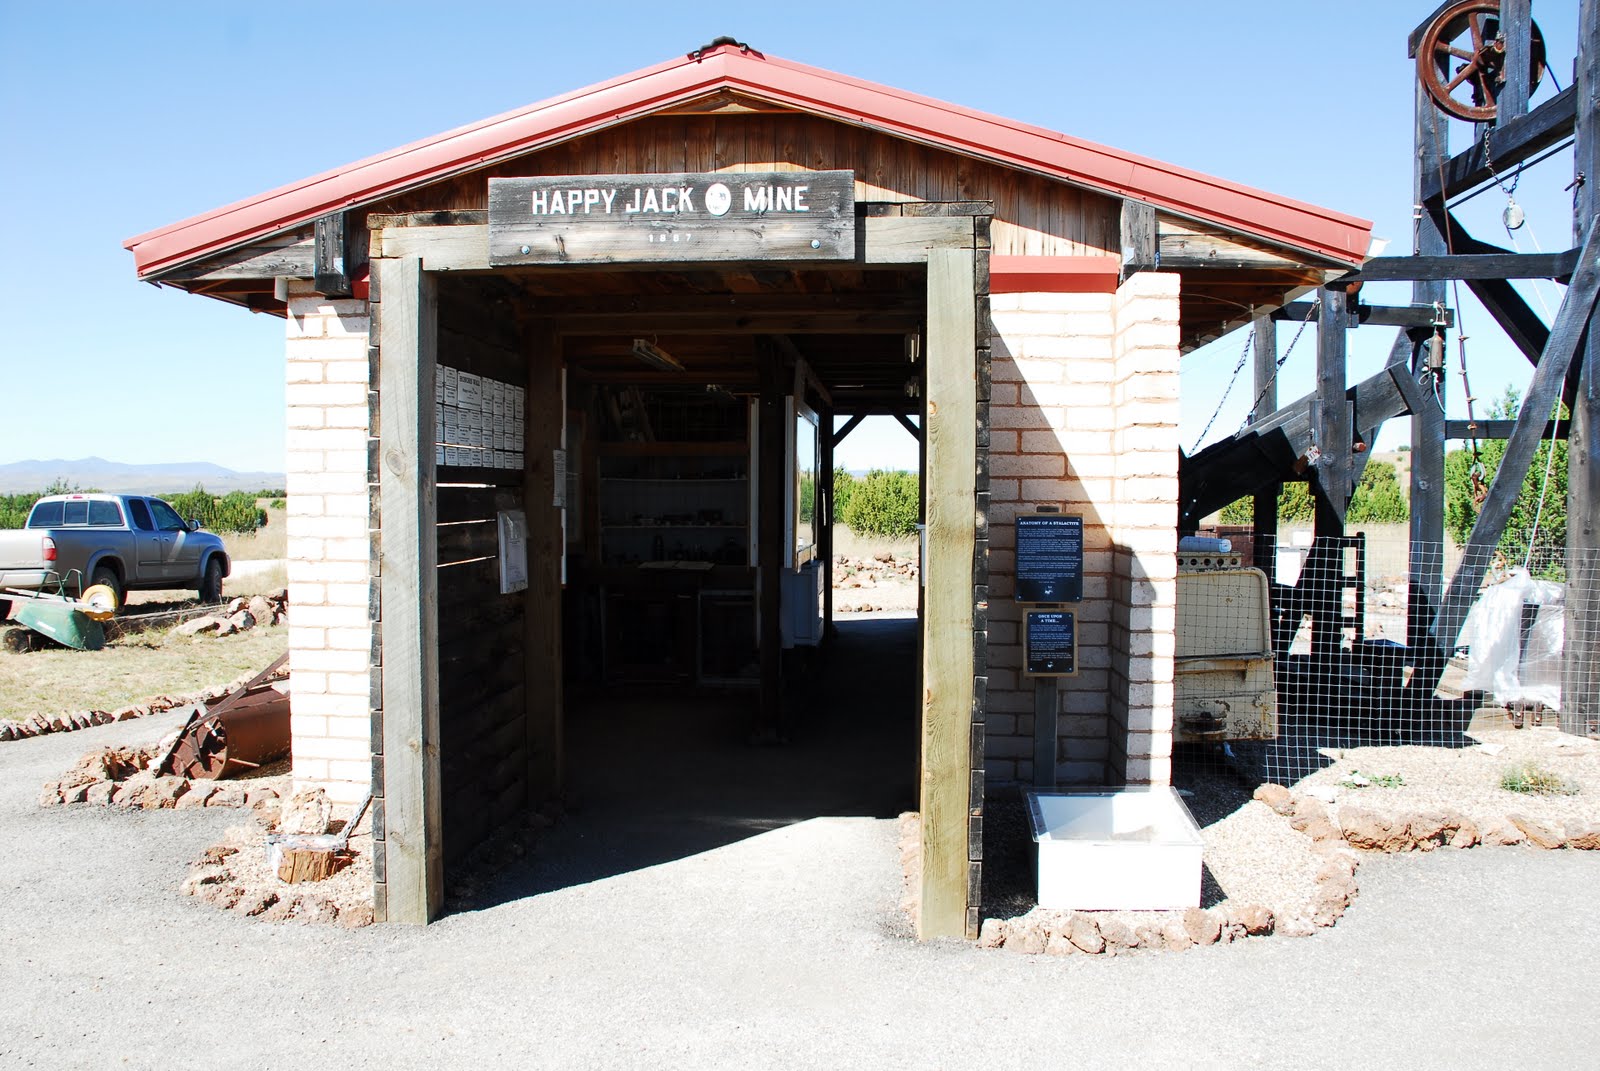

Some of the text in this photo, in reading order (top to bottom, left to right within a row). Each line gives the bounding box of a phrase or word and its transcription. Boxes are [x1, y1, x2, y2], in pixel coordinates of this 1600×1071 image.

[532, 185, 810, 215] HAPPY JACK MINE
